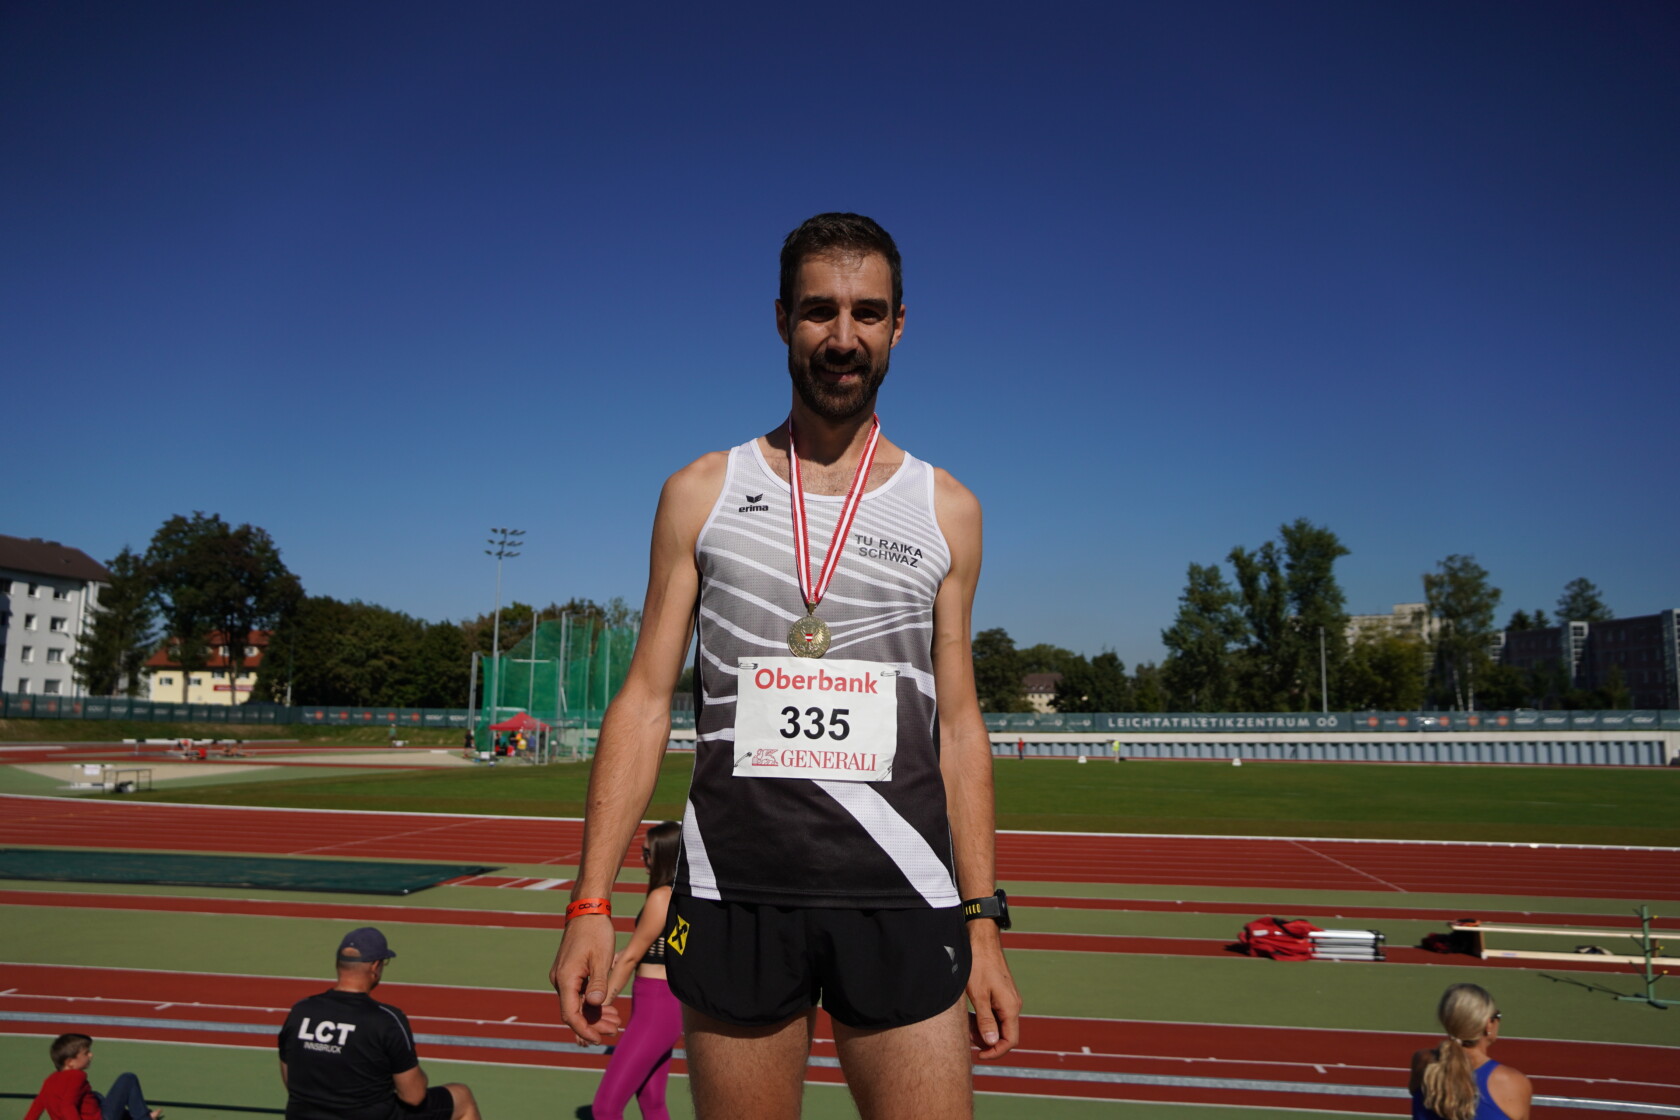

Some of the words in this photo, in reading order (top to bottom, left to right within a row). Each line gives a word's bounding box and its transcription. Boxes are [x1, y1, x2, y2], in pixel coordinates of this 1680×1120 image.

[738, 503, 769, 513] erima
[855, 534, 873, 546] TU
[879, 539, 923, 559] RAIKA
[858, 547, 918, 568] SCHWAZ
[755, 668, 878, 694] Oberbank
[779, 706, 850, 741] 335
[1108, 717, 1310, 728] LEICHTATHLETIKZENTRUM
[780, 750, 878, 771] GENERALI
[298, 1017, 356, 1046] LCT
